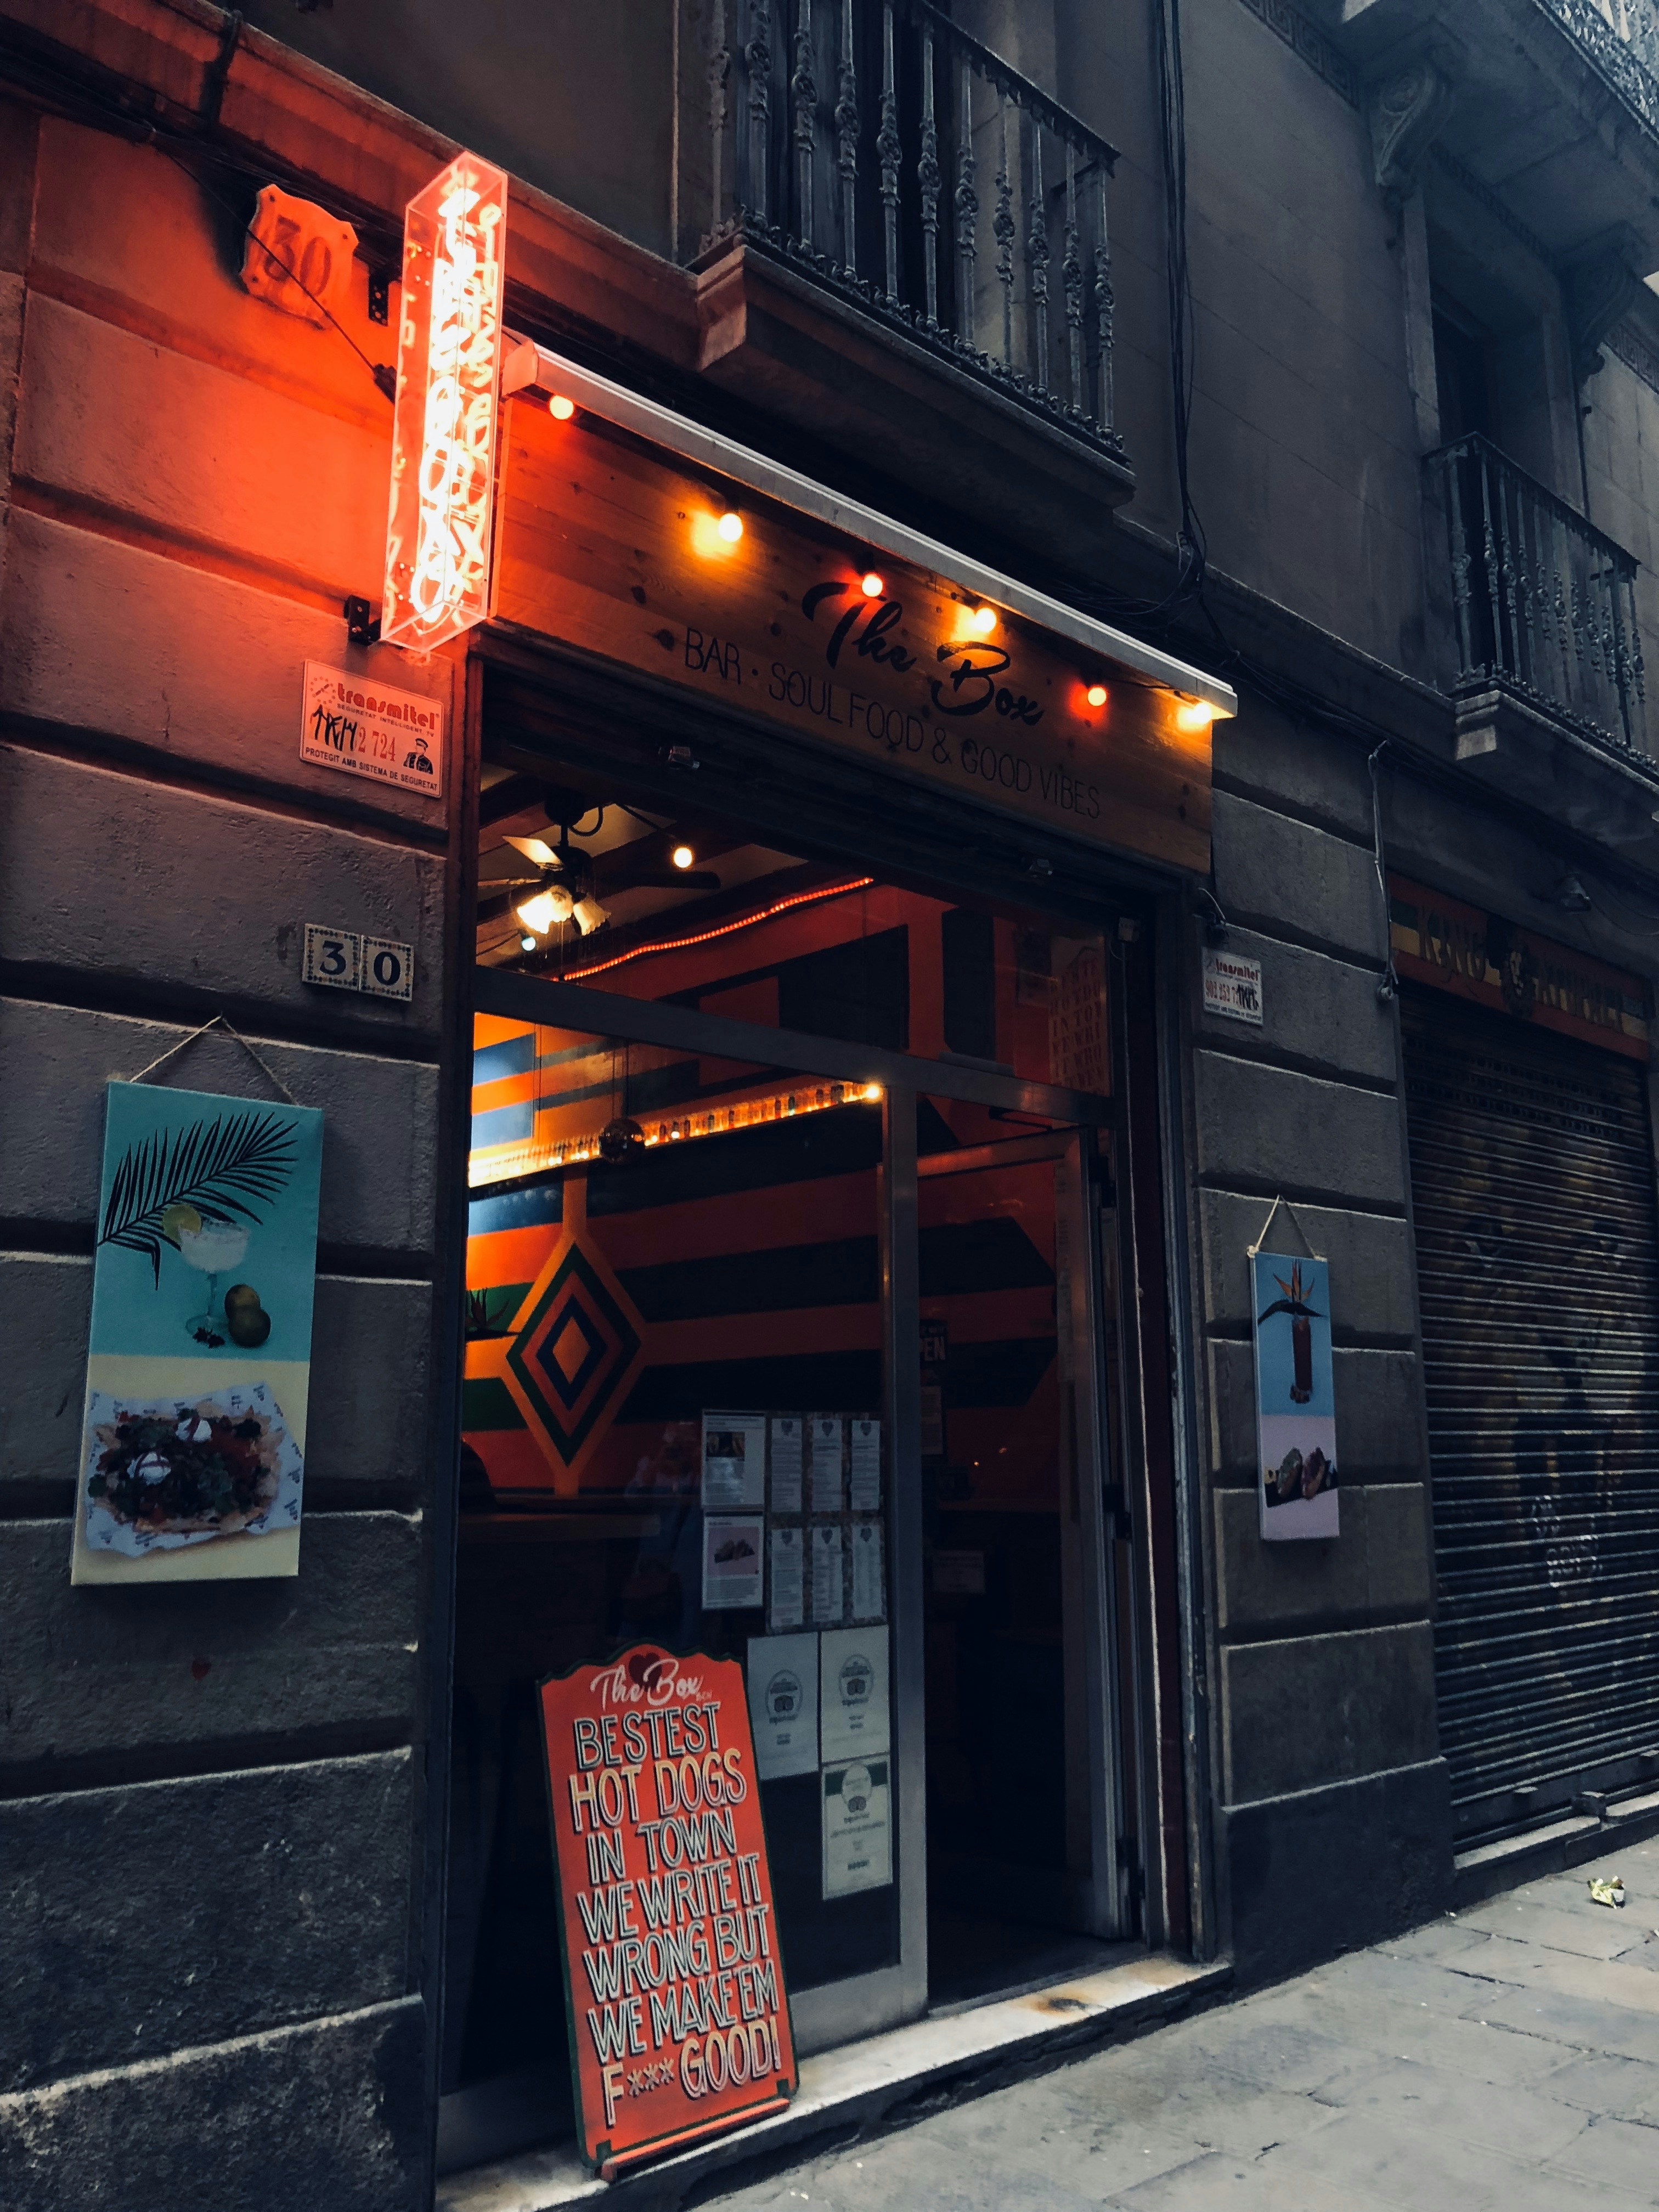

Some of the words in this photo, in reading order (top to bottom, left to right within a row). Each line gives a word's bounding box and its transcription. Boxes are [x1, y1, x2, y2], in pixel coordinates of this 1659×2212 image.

[264, 214, 331, 297] 30
[802, 582, 917, 673] The
[931, 641, 1044, 726] Box
[337, 682, 435, 730] transmitel
[372, 731, 396, 762] 724
[685, 626, 741, 685] BAR
[769, 662, 843, 724] SOUL
[849, 692, 924, 752] FOOD
[933, 727, 952, 764] &
[961, 738, 1032, 792] GOOD
[1040, 766, 1101, 819] VIBES
[306, 747, 340, 763] PROTEGIT
[341, 757, 357, 768] AMB
[359, 762, 387, 776] SISTEMA
[389, 771, 398, 780] DE
[400, 774, 437, 791] SEGURETAT
[590, 1664, 644, 1710] The
[641, 1658, 704, 1706] Box
[573, 1701, 721, 1771] BESTEST
[569, 1764, 642, 1832] HOT
[655, 1747, 747, 1816] DOGS
[586, 1827, 626, 1886] IN
[636, 1807, 737, 1872] TOWN
[577, 1880, 639, 1945] WE
[637, 1858, 737, 1931] WRITE
[736, 1852, 763, 1906] IT
[582, 1920, 711, 2004] WRONG
[713, 1903, 770, 1971] BUT
[587, 1996, 647, 2066] WE
[648, 1970, 737, 2047] MAKE
[680, 2017, 782, 2100] GOOD!
